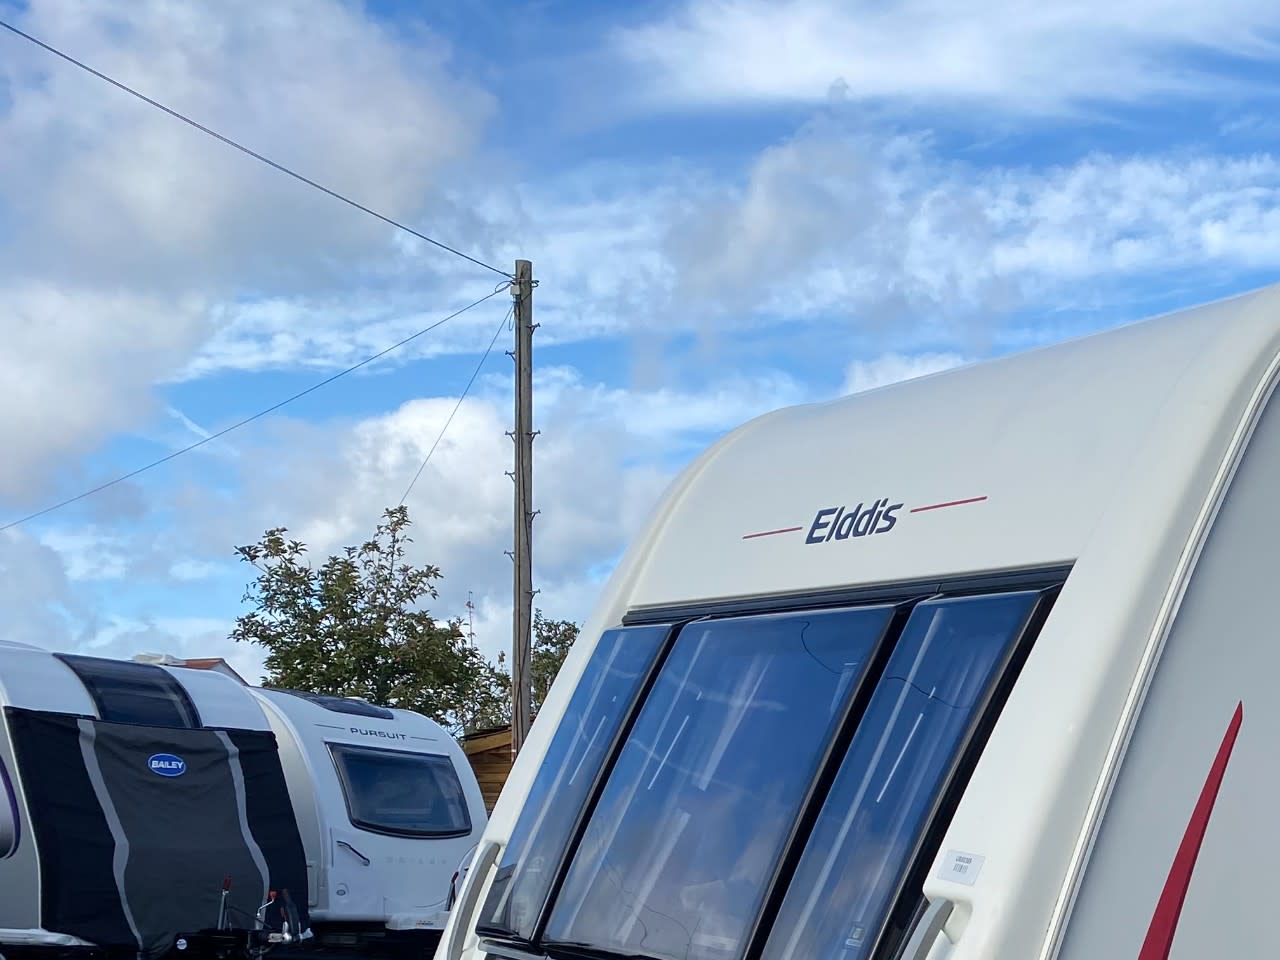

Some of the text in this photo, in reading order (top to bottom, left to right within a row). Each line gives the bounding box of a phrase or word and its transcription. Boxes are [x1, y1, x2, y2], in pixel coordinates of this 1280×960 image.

[805, 498, 904, 544] Elddis
[350, 728, 406, 741] PURSUIT
[151, 760, 185, 769] BAILEY
